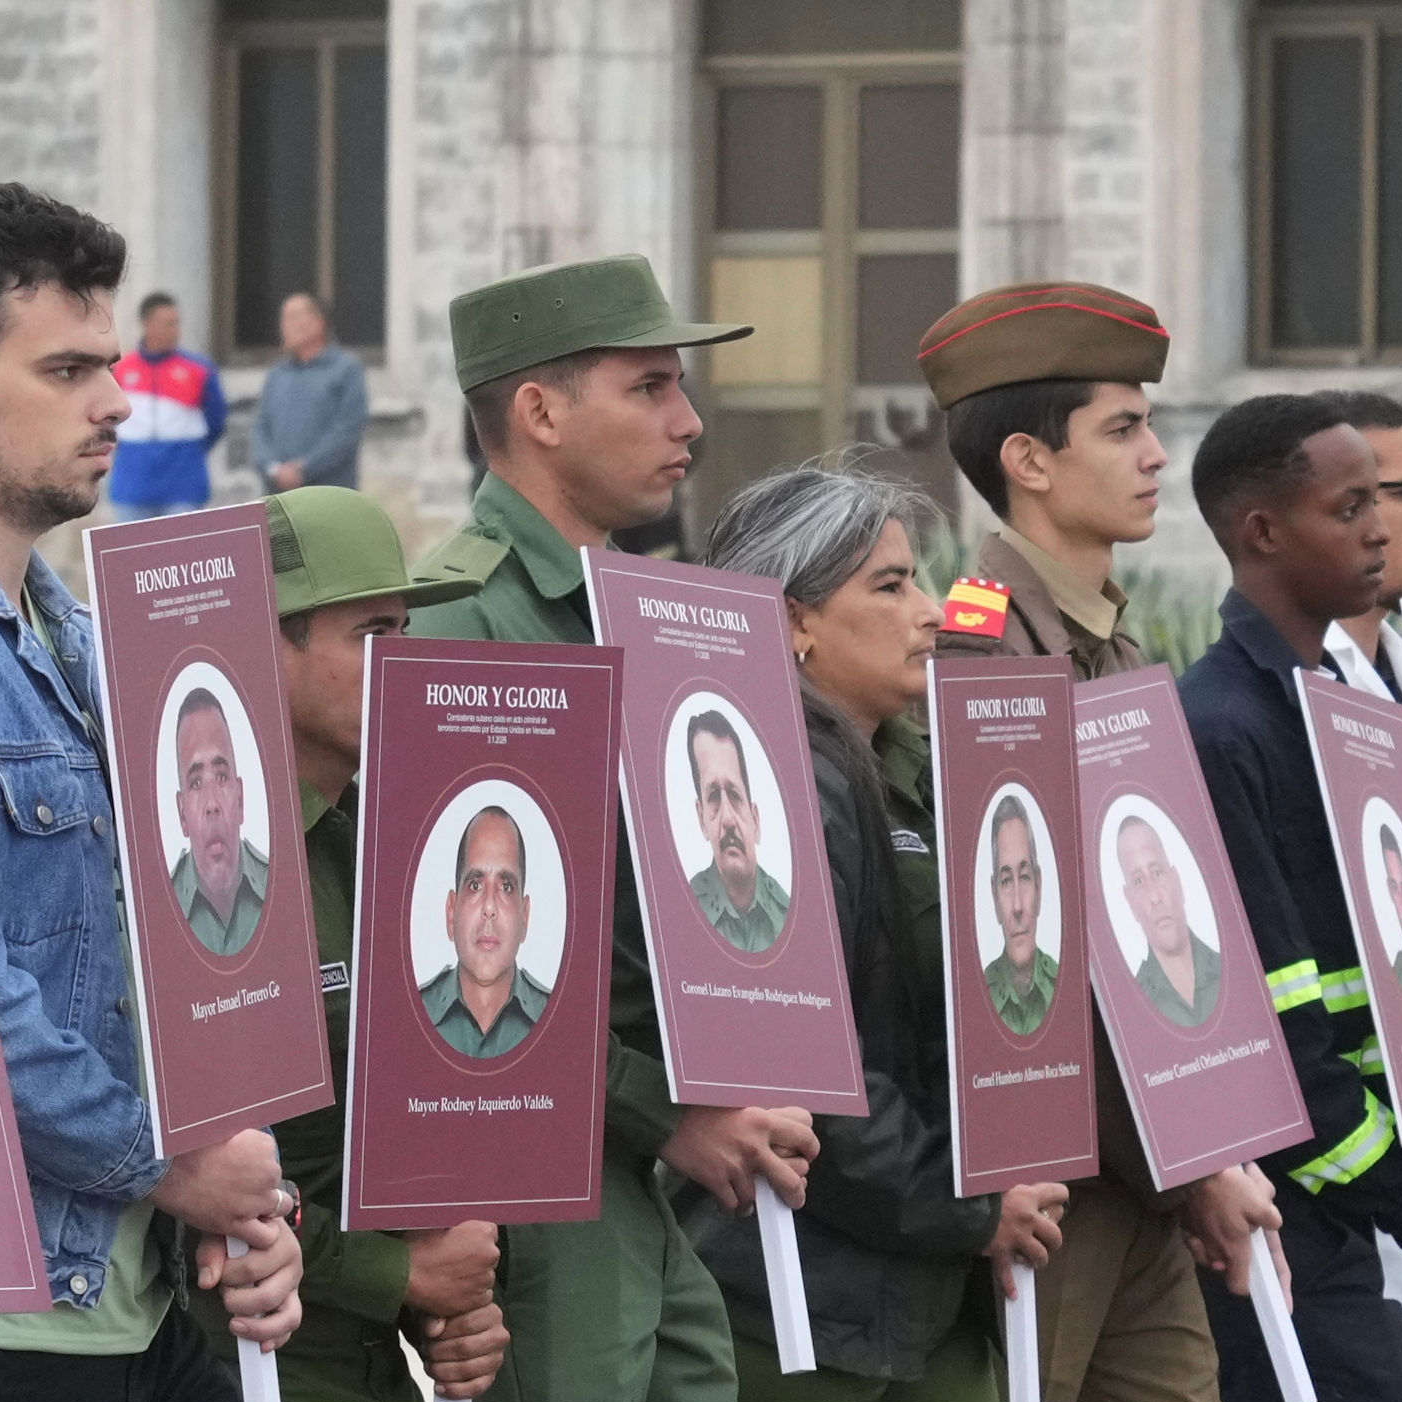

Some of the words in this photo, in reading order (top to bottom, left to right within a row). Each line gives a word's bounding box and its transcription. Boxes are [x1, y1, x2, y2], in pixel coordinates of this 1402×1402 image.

[134, 565, 180, 594] HONOR
[180, 563, 189, 586] Y
[191, 556, 236, 584] GLORIA
[637, 596, 689, 624] HONOR
[688, 605, 698, 625] Y
[701, 607, 750, 634] GLORIA
[426, 684, 488, 706] HONOR
[492, 686, 503, 707] Y
[506, 687, 568, 709] GLORIA
[966, 699, 1003, 719] HONOR
[1003, 699, 1009, 718] Y
[1011, 697, 1047, 717] GLORIA
[1075, 719, 1100, 743] NOR
[1098, 718, 1108, 736] Y
[1107, 708, 1151, 734] GLORIA
[1331, 712, 1360, 738] HONOR
[1359, 723, 1367, 740] Y
[1366, 724, 1395, 750] GLORIA
[191, 1002, 216, 1023] Mayor
[217, 990, 241, 1014] Ismael
[241, 988, 269, 1008] Terrero
[268, 980, 280, 999] Ge
[681, 980, 709, 996] Coronel
[708, 983, 732, 998] Lázaro
[732, 985, 764, 1004] Evangelio
[764, 988, 798, 1007] Rodríguez
[798, 991, 832, 1010] Rodríguez
[1143, 1068, 1175, 1088] Teniente
[1173, 1058, 1201, 1078] Coronel
[1200, 1049, 1229, 1069] Orlando
[1249, 1038, 1271, 1055] López
[407, 1097, 439, 1118] Mayor
[441, 1096, 476, 1116] Rodney
[478, 1095, 522, 1115] Izquierdo
[524, 1094, 554, 1110] Valdés
